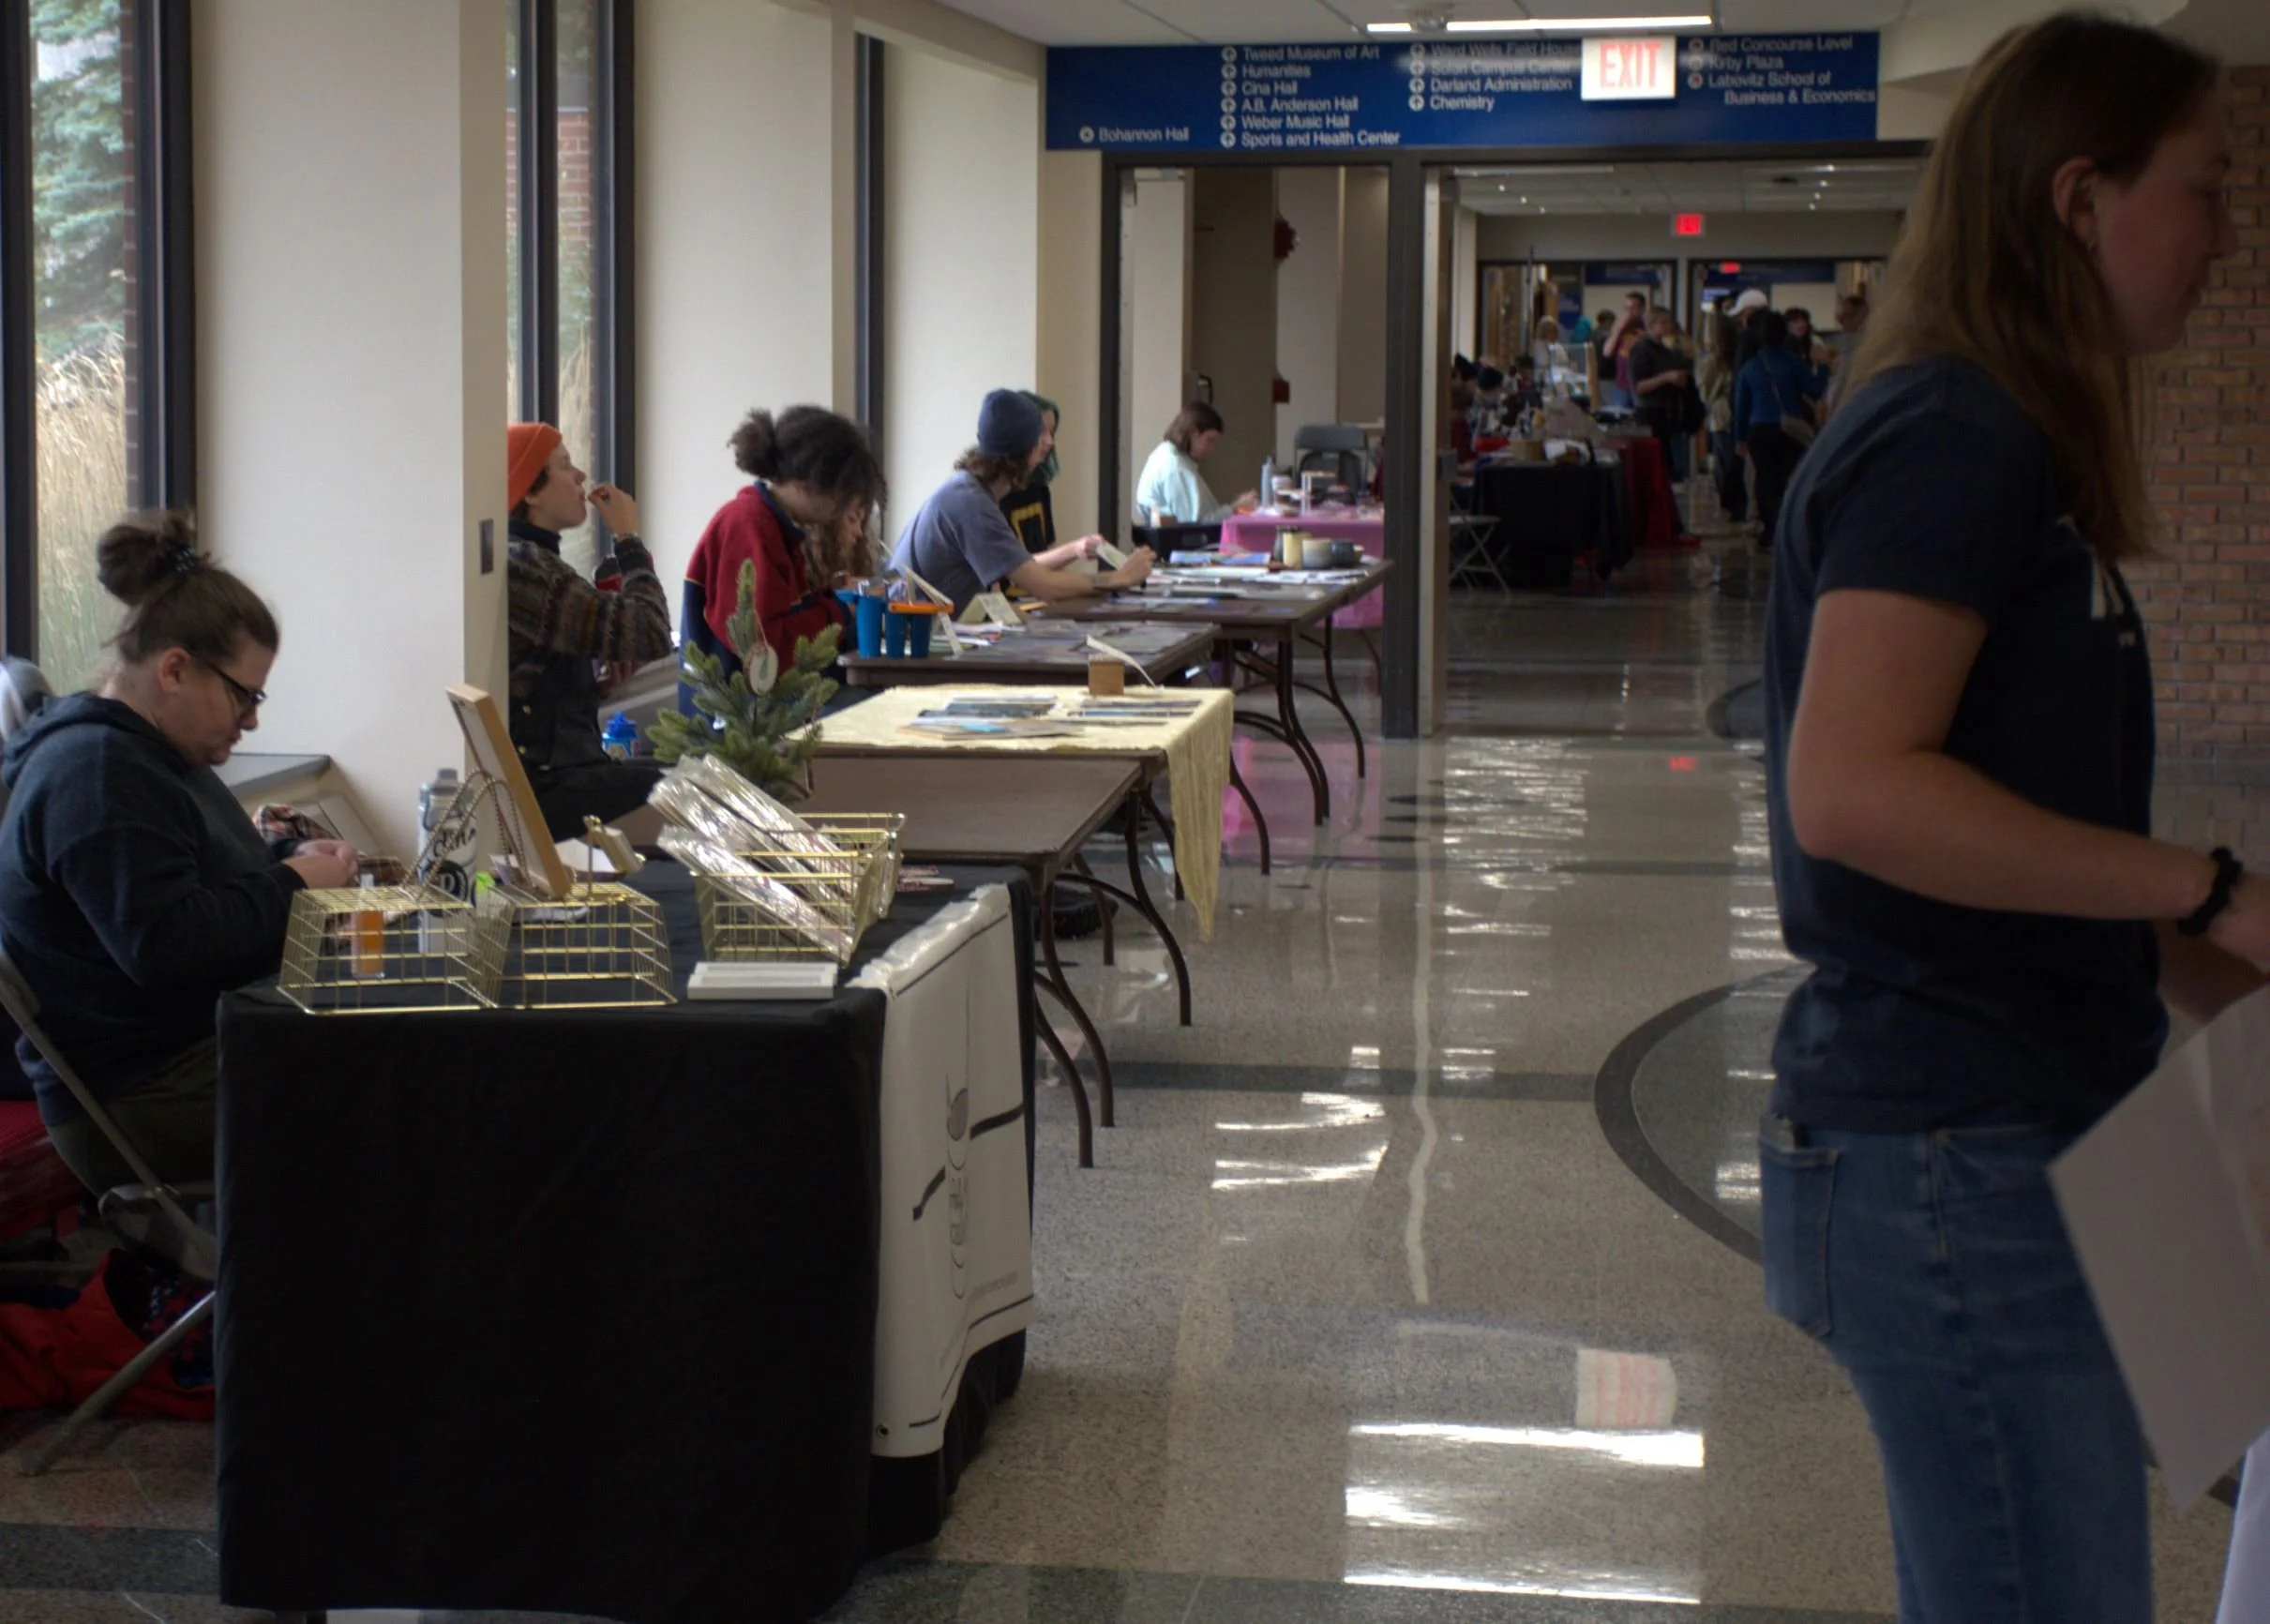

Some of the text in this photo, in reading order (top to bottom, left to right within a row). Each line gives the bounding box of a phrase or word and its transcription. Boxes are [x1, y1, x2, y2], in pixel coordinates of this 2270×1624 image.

[1710, 35, 1853, 53] Red Concourse Level
[1244, 46, 1379, 60] Tweed Museum of Art
[1746, 54, 1784, 68] Plaza
[1241, 65, 1311, 78] Humanities
[1471, 60, 1526, 76] Campus
[1600, 40, 1661, 88] EXIT
[1431, 76, 1572, 92] Darland Administration
[1708, 70, 1831, 87] Labovitz School of
[1241, 80, 1298, 95] Cina Hall
[1241, 96, 1358, 112] A.B. Anderson Hall
[1430, 95, 1495, 113] Chemistry
[1724, 87, 1875, 105] Business & Economics
[1241, 113, 1350, 128] Weber Music Hall
[1099, 126, 1189, 142] Bohannon Hall
[1240, 129, 1400, 149] Sports and Health Center
